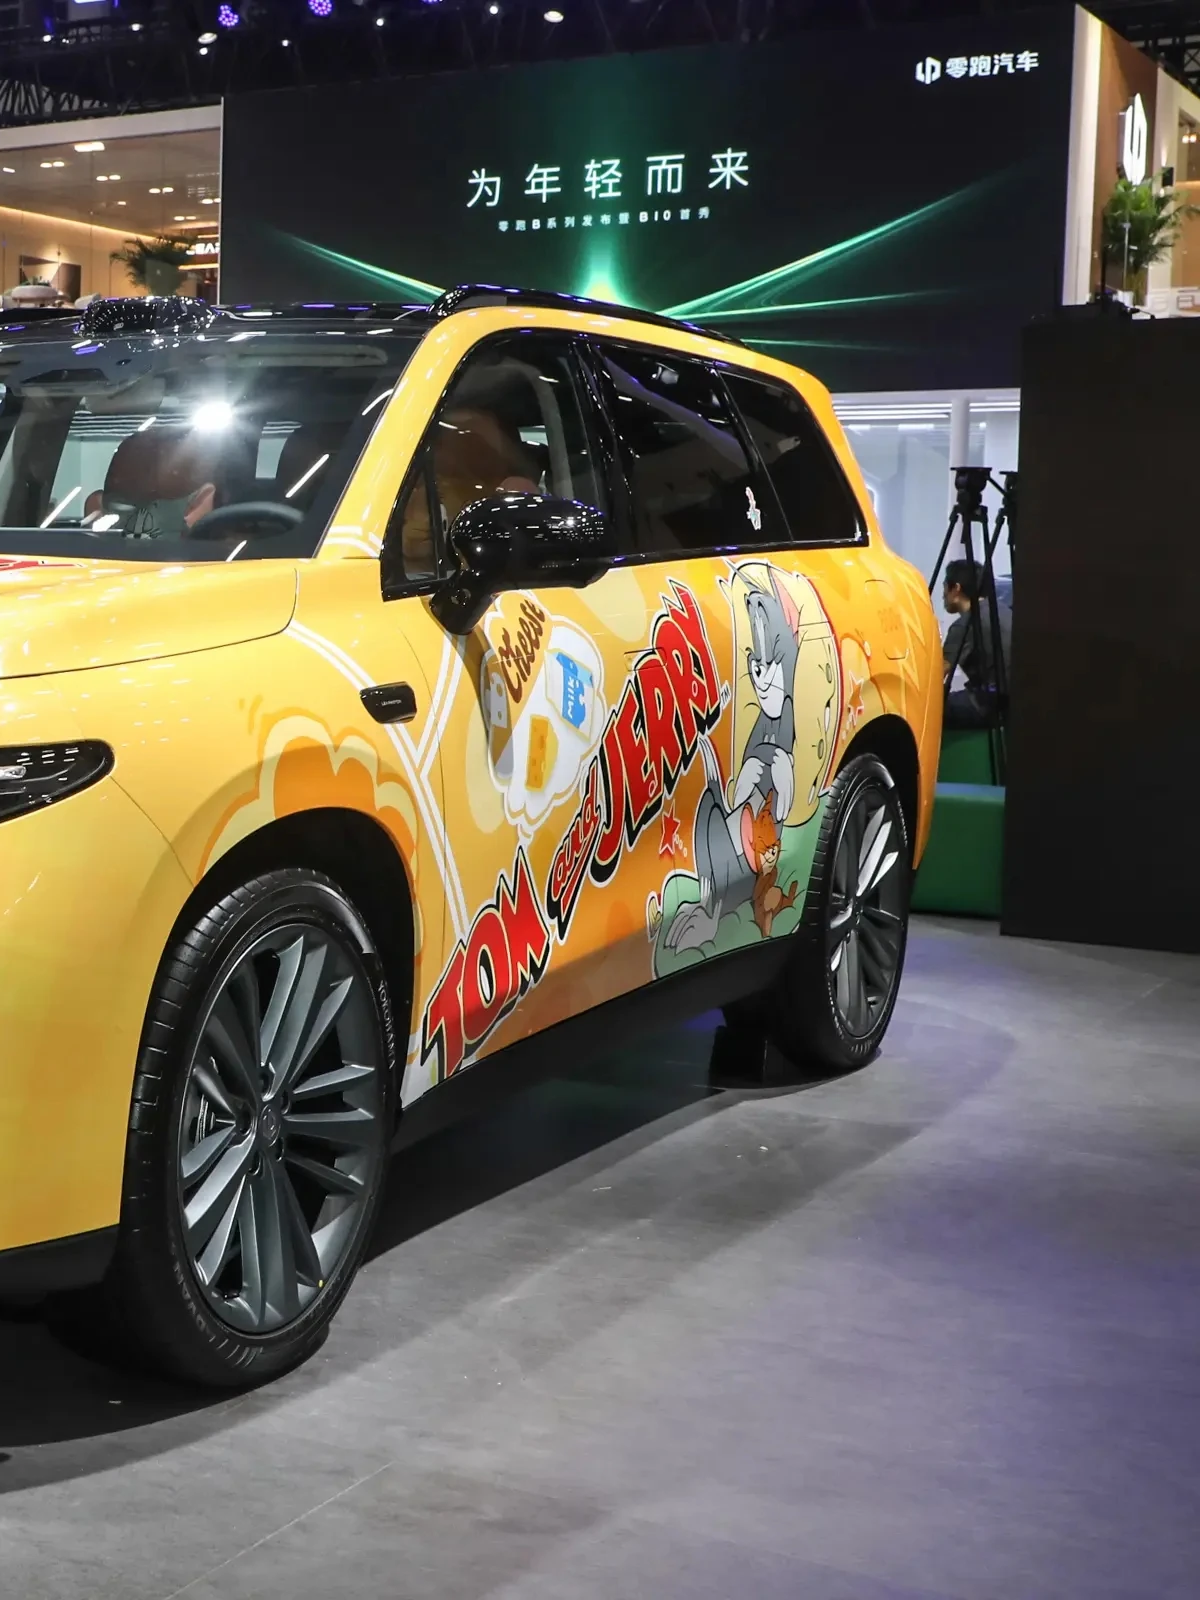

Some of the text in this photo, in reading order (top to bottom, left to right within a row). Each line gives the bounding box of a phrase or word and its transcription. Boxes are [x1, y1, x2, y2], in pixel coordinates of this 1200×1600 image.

[945, 50, 1039, 78] 零跑汽车
[466, 148, 749, 208] 为年轻而来
[498, 599, 546, 704] Cheese
[421, 846, 550, 1078] TOM
[547, 757, 603, 943] and
[591, 578, 721, 886] JERRY
